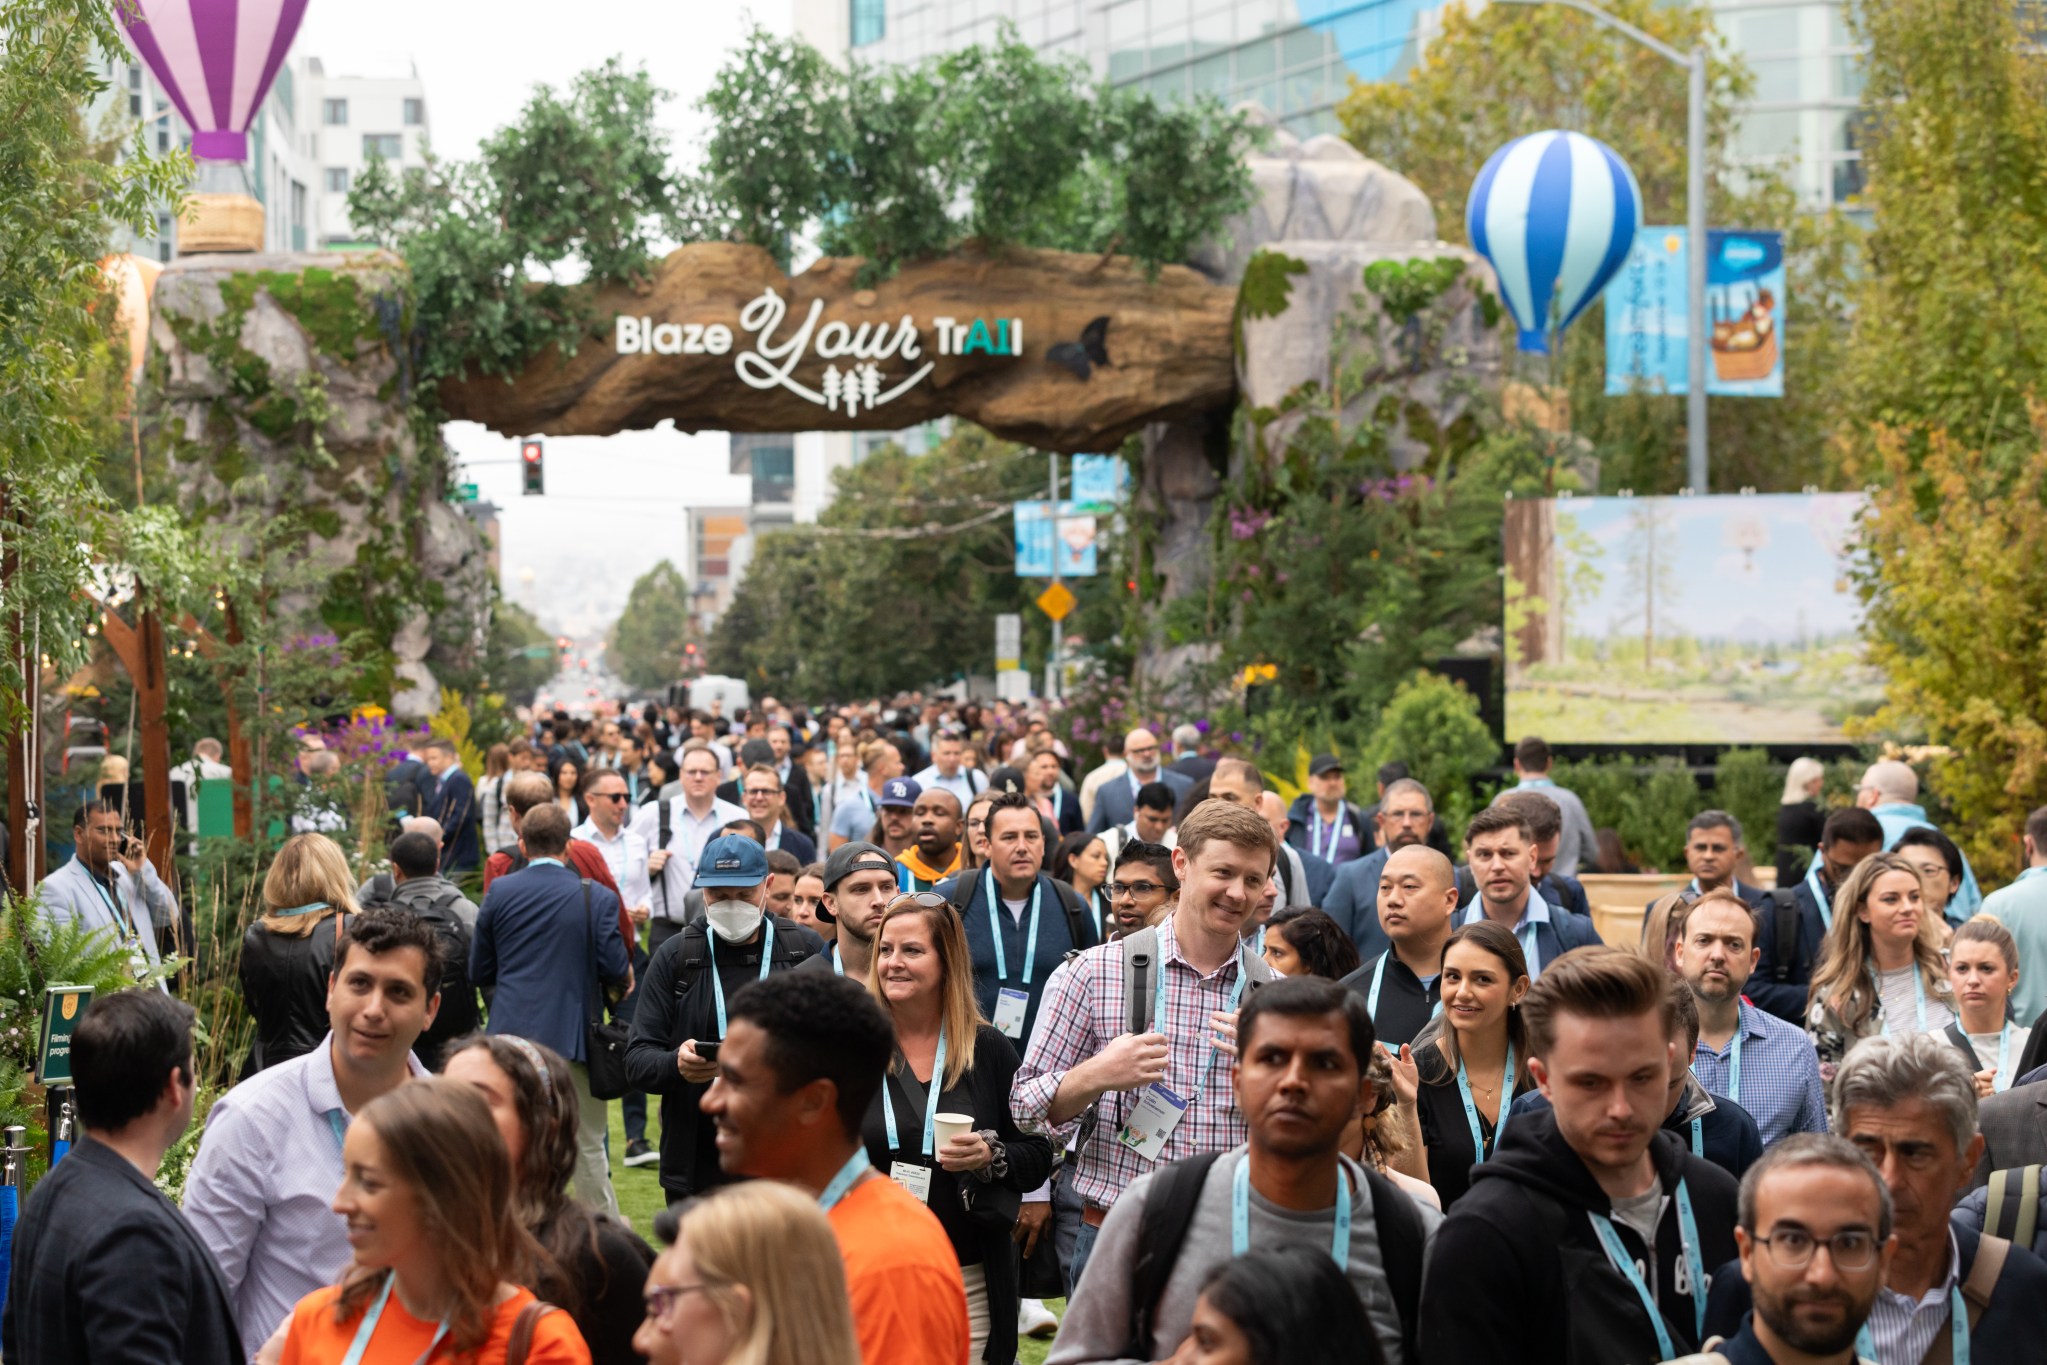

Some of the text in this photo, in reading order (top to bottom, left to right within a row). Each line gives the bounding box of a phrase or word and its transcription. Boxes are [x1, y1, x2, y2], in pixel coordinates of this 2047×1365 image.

[617, 287, 1023, 402] Blaze Your TrAIl
[49, 1046, 71, 1057] progre
